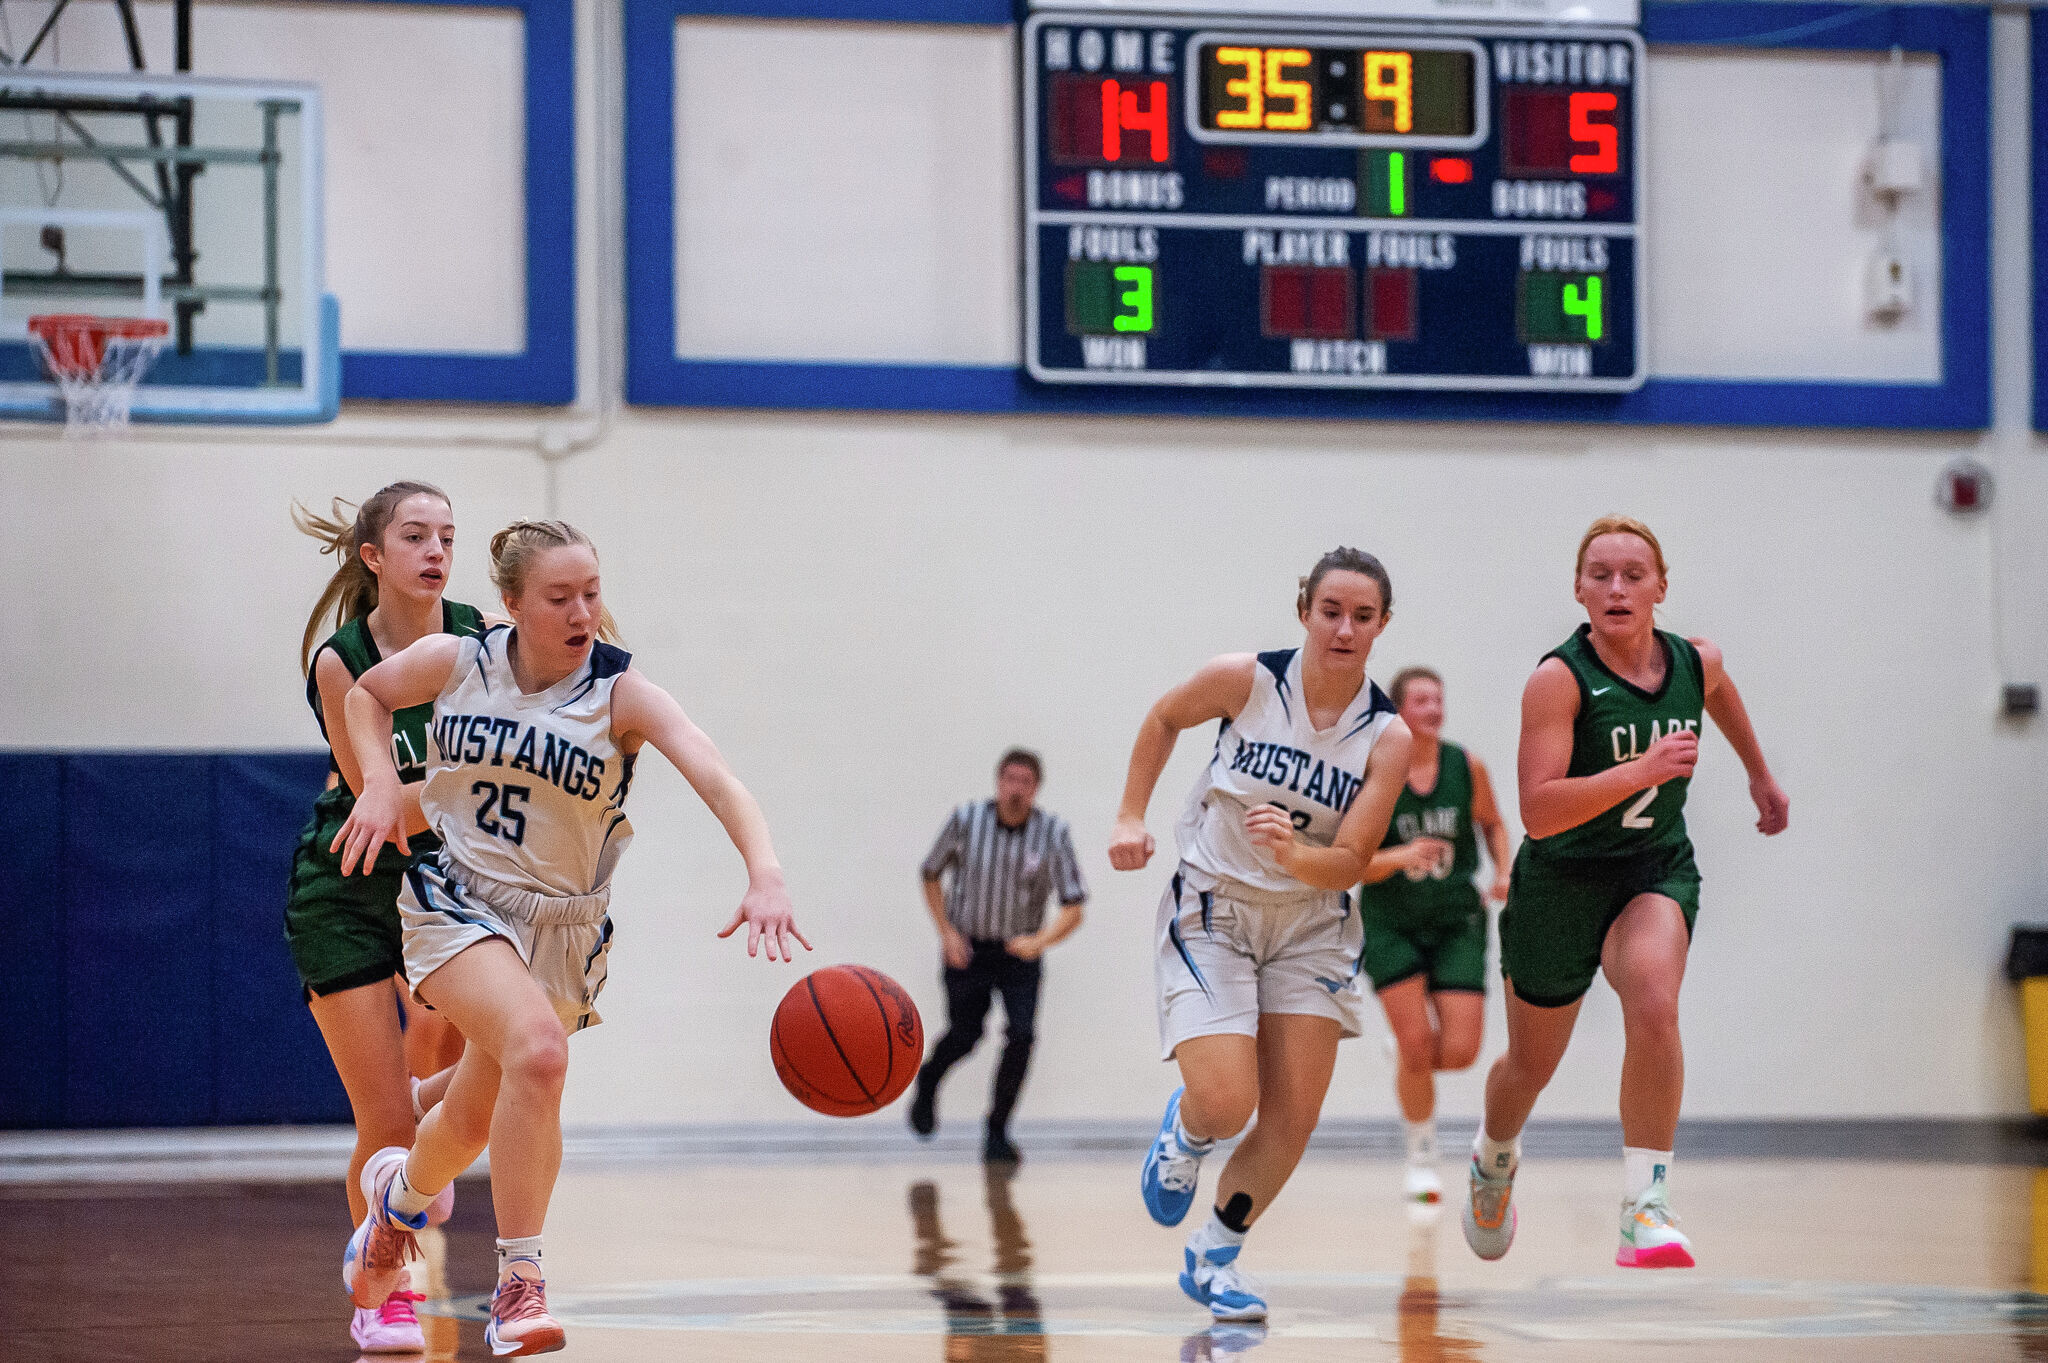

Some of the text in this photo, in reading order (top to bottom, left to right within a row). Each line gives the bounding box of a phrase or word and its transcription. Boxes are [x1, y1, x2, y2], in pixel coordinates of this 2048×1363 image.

[1045, 28, 1176, 73] HOME
[1494, 42, 1631, 85] VISITOR
[1101, 79, 1169, 162] 14
[1569, 92, 1618, 173] 5
[1087, 171, 1184, 208] BONUS
[1265, 177, 1355, 211] PERIOD
[1389, 152, 1404, 215] 1
[1492, 180, 1587, 218] BONUS
[1068, 226, 1159, 262] FOULS
[1242, 229, 1456, 270] PLAYER FOULS
[1520, 233, 1609, 272] FOULS
[1113, 266, 1153, 331] 3
[1563, 276, 1602, 340] 4
[1082, 335, 1147, 368] WIN
[1290, 338, 1387, 372] MATCH
[1527, 343, 1593, 377] WIN
[432, 714, 605, 802] MUSTANGS
[471, 779, 531, 847] 25
